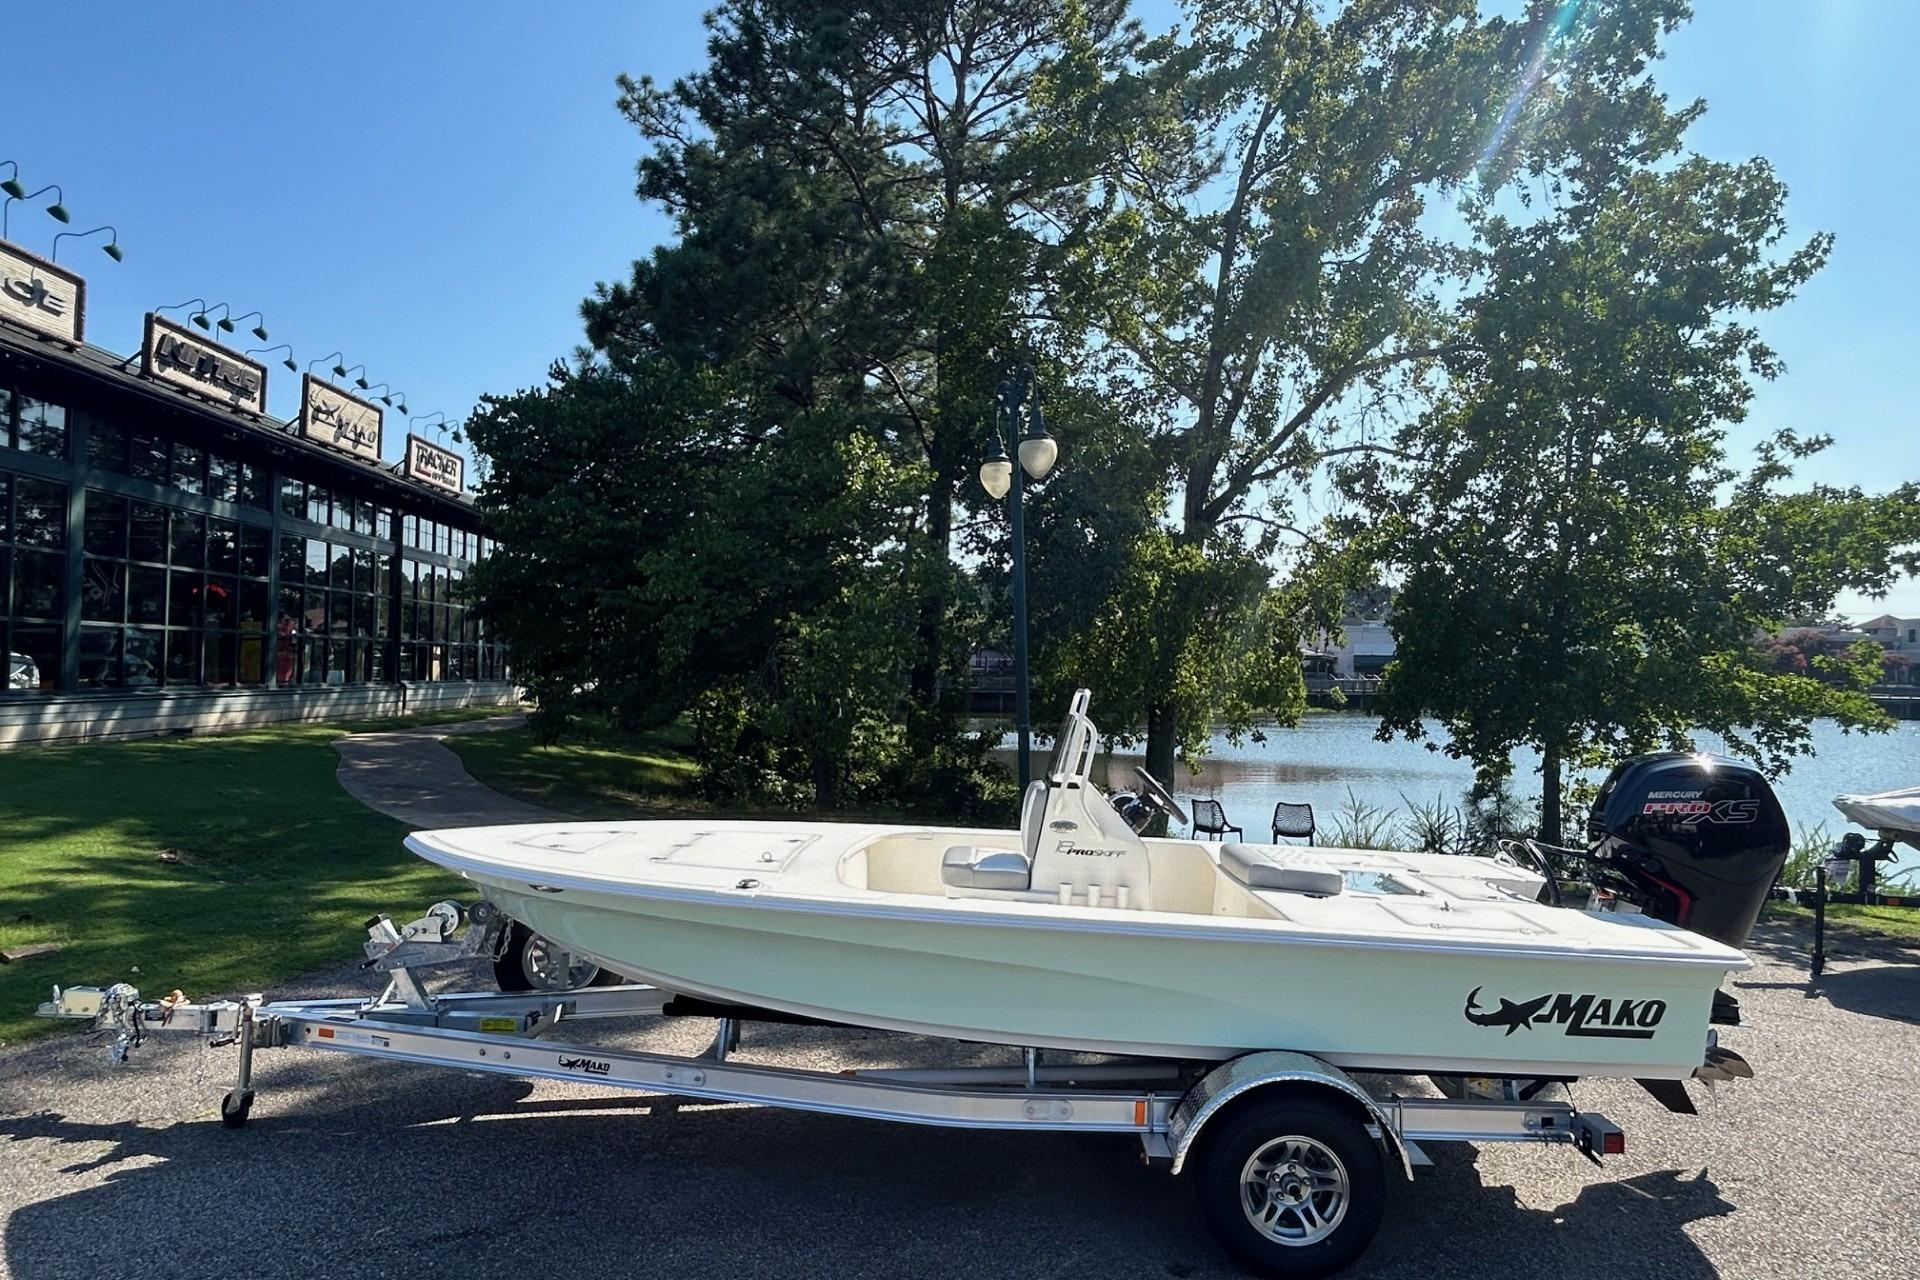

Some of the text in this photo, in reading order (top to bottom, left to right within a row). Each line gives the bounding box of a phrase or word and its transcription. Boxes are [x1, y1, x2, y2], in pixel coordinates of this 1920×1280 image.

[415, 442, 457, 478] TRACKER
[1648, 791, 1703, 799] MERCURY
[1532, 993, 1667, 1039] MAKO
[577, 1059, 610, 1075] MAKO
